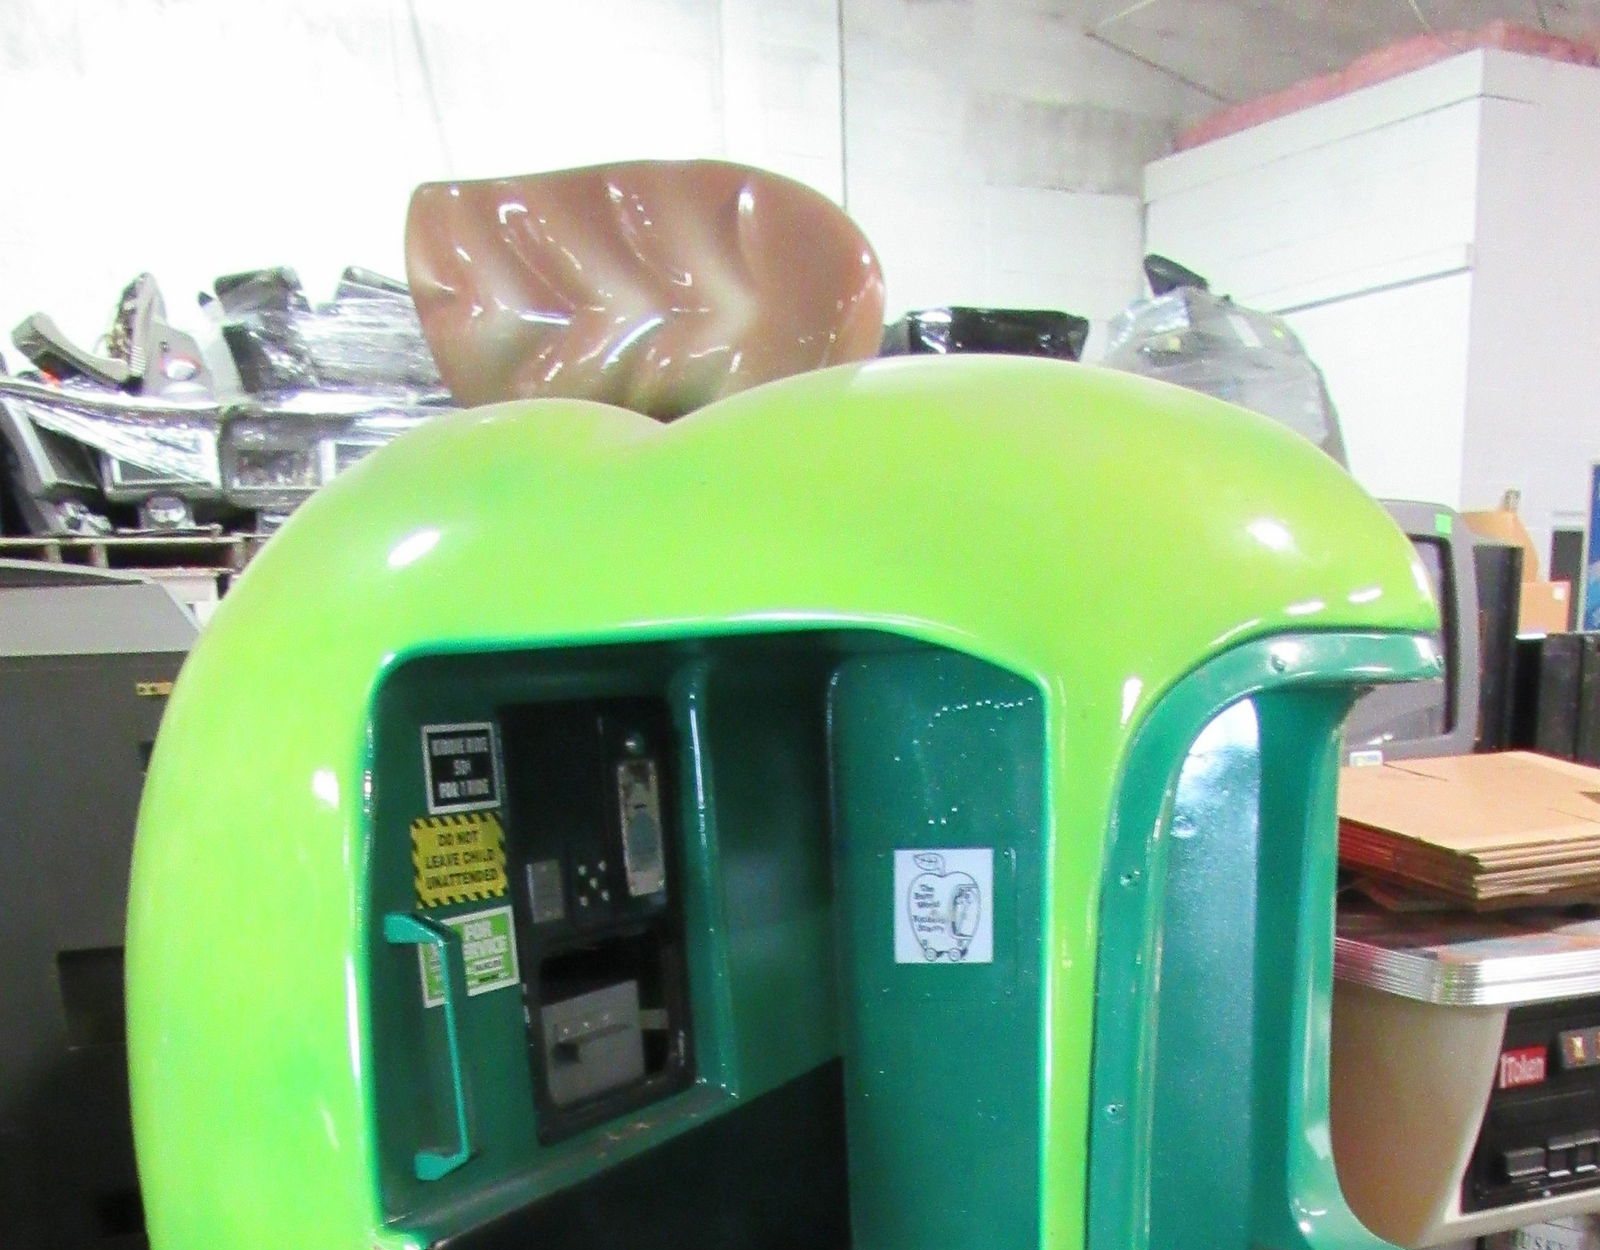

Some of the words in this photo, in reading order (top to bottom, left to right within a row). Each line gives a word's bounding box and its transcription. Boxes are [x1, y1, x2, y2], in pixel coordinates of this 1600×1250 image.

[438, 832, 455, 847] DO
[457, 830, 478, 845] NOT
[426, 852, 460, 869] LEAVE
[463, 848, 495, 865] CHILD
[426, 867, 499, 891] UNATTENDED
